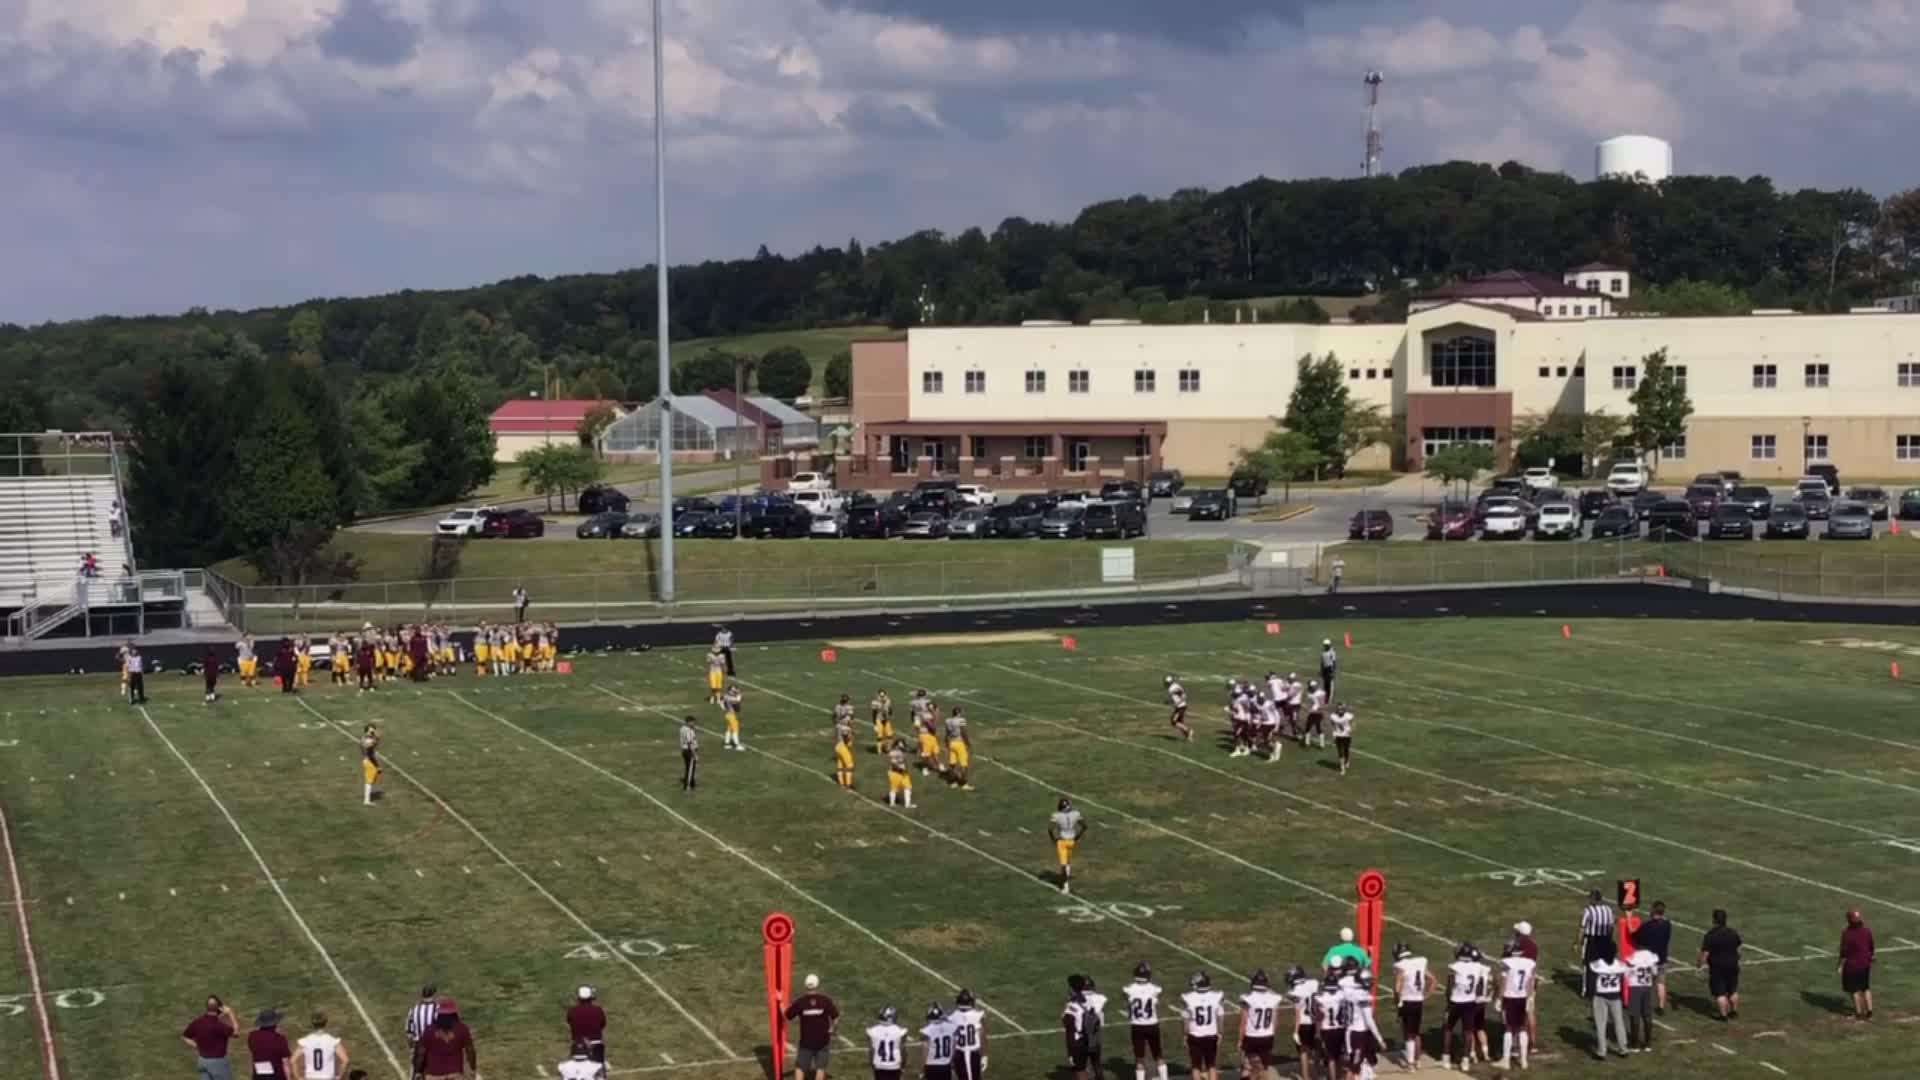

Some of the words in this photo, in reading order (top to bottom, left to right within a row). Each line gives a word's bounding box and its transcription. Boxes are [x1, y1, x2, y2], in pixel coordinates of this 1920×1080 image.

[1622, 880, 1637, 905] 2
[1057, 902, 1154, 923] 30
[563, 939, 666, 960] 40
[1414, 970, 1422, 991] 4
[1518, 970, 1525, 991] 7
[1132, 998, 1152, 1018] 24
[1195, 1005, 1212, 1026] 61
[877, 1040, 896, 1062] 41
[934, 1035, 951, 1059] 10
[313, 1048, 323, 1071] 0
